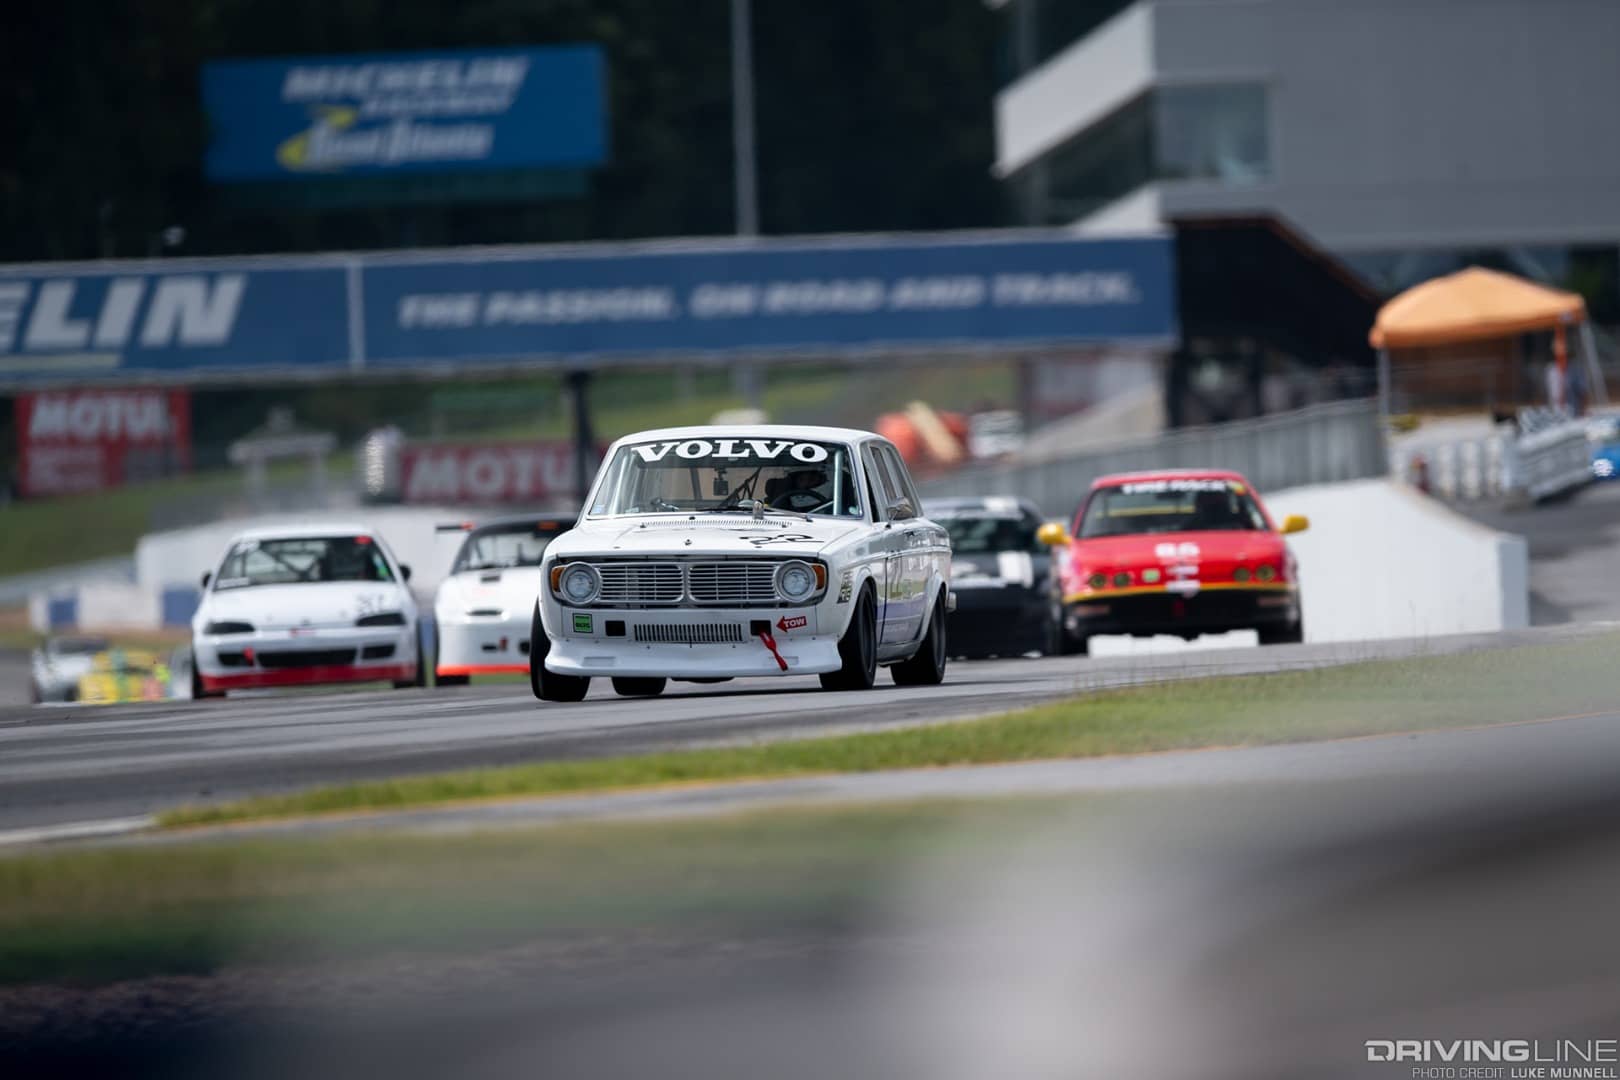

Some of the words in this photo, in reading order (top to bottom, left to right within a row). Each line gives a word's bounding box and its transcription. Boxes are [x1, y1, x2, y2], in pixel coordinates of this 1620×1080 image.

[399, 292, 479, 329] THE
[631, 439, 828, 463] VOLVO
[784, 618, 805, 628] TOW
